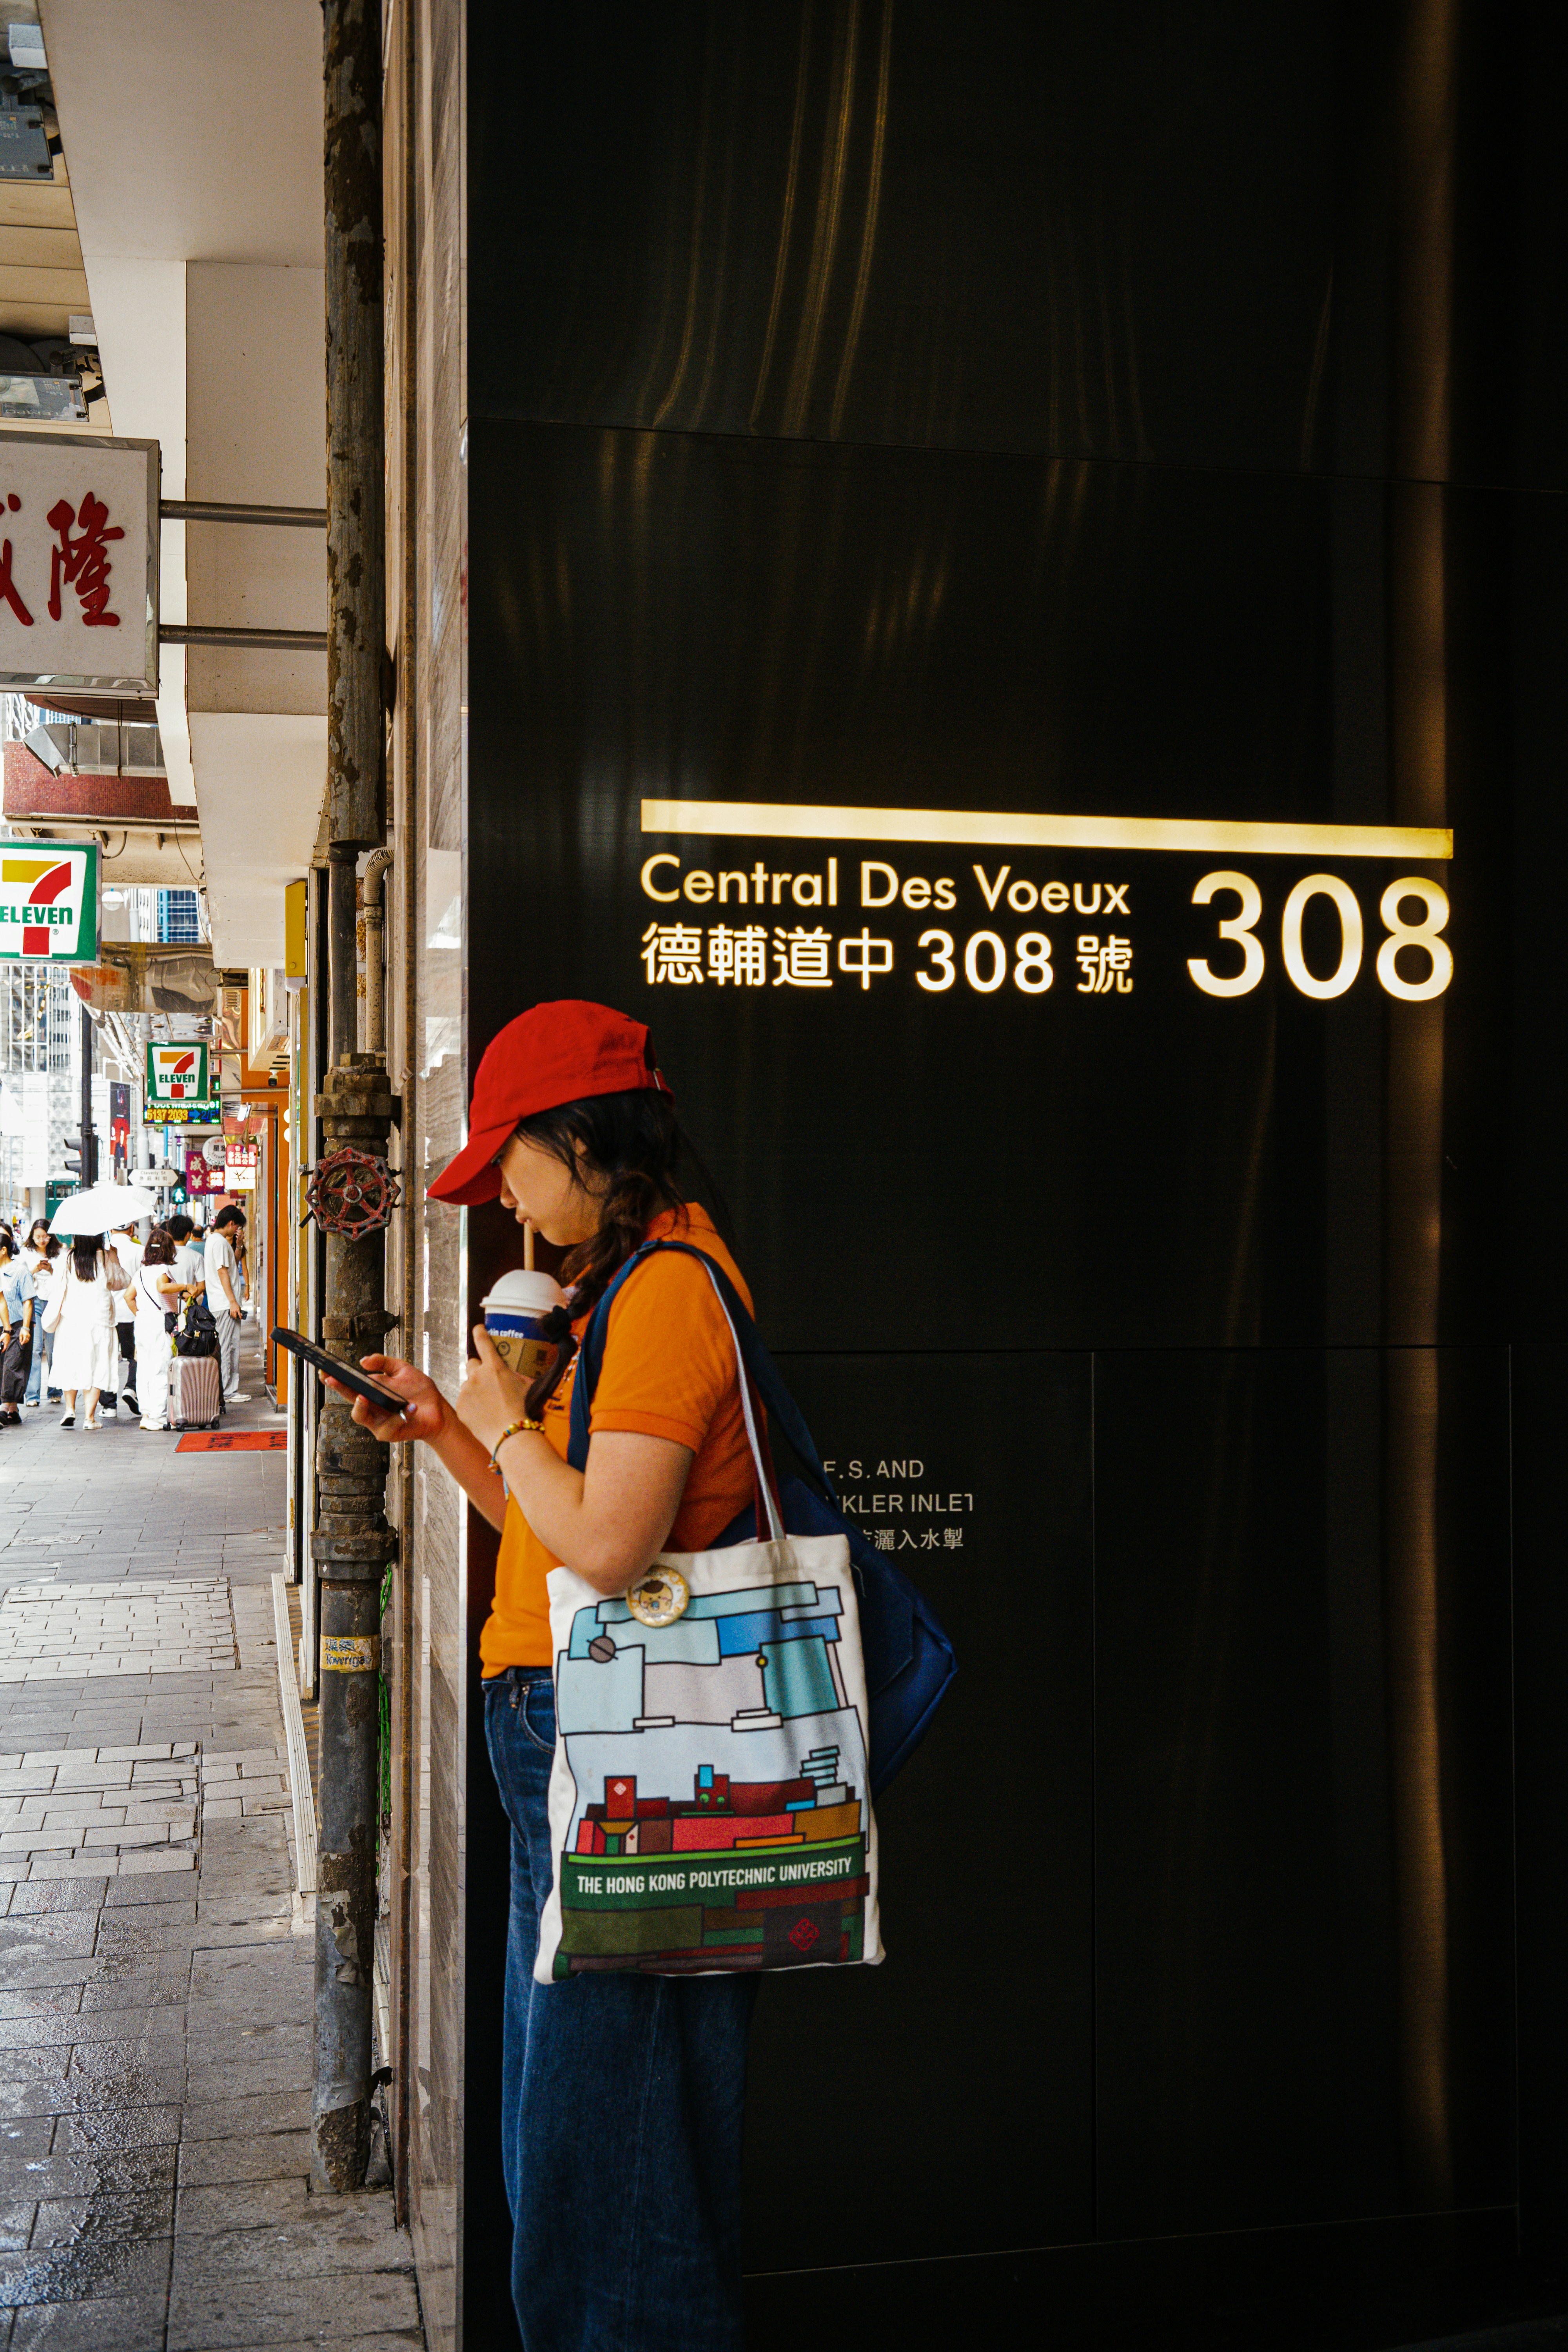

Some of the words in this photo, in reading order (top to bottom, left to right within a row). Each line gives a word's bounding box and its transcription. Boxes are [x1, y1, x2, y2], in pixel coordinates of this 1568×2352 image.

[641, 853, 837, 906] Central
[861, 861, 956, 910] Des
[973, 865, 1131, 914] Voeux
[1187, 871, 1454, 1002] 308
[641, 922, 893, 990] 德輔道中
[916, 929, 1053, 993] 308
[1076, 935, 1133, 993] 號
[168, 1109, 188, 1120] 2033
[500, 1329, 524, 1339] coffee
[826, 1494, 904, 1514] KLER
[577, 1876, 603, 1894] THE
[606, 1876, 645, 1894] HONG
[649, 1873, 685, 1892] KONG
[690, 1866, 776, 1889] POLYTECHNIC
[780, 1857, 852, 1881] UNIVERSITY
